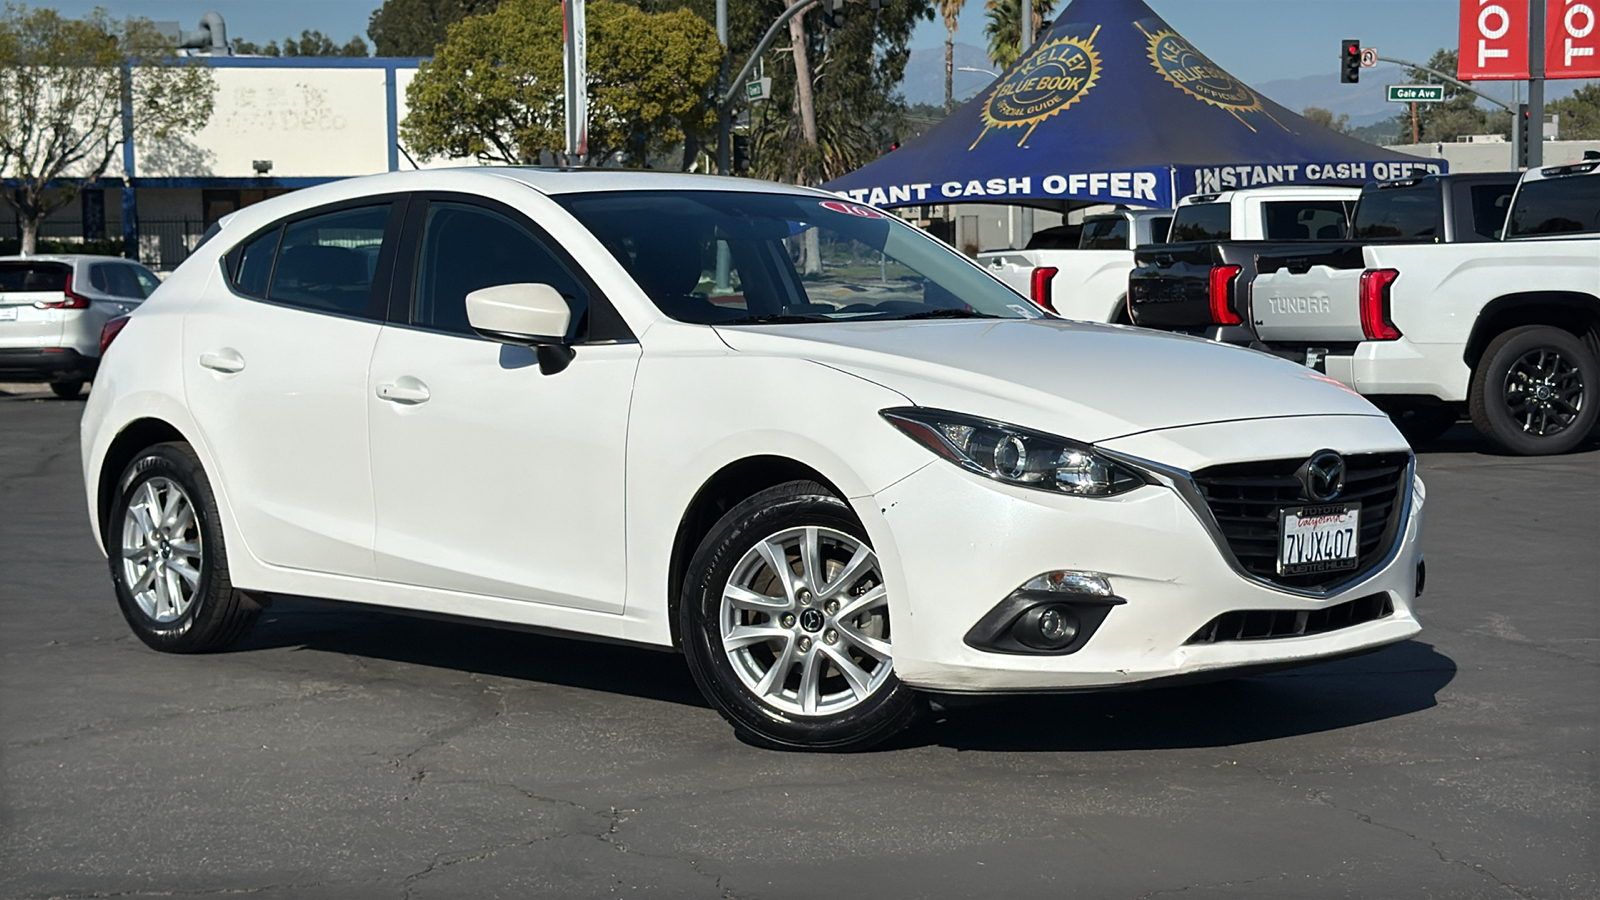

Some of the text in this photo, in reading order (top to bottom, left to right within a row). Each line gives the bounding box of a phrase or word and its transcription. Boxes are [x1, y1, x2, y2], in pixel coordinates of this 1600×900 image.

[1478, 0, 1509, 67] TO
[1564, 0, 1595, 66] TO
[1021, 47, 1087, 75] KELLEY
[1169, 65, 1211, 83] BLUE
[997, 76, 1085, 97] BLUE BOOK
[1397, 89, 1435, 98] Gale Ave
[1026, 95, 1063, 114] GUIDE
[941, 176, 1031, 197] CASH
[1042, 172, 1157, 201] OFFER
[1194, 164, 1298, 195] INSTANT
[1305, 162, 1367, 181] CASH
[841, 203, 869, 216] 16
[1268, 296, 1330, 314] TUNDRA
[1304, 505, 1343, 515] TOYOTA
[1286, 528, 1353, 564] 7VJX407
